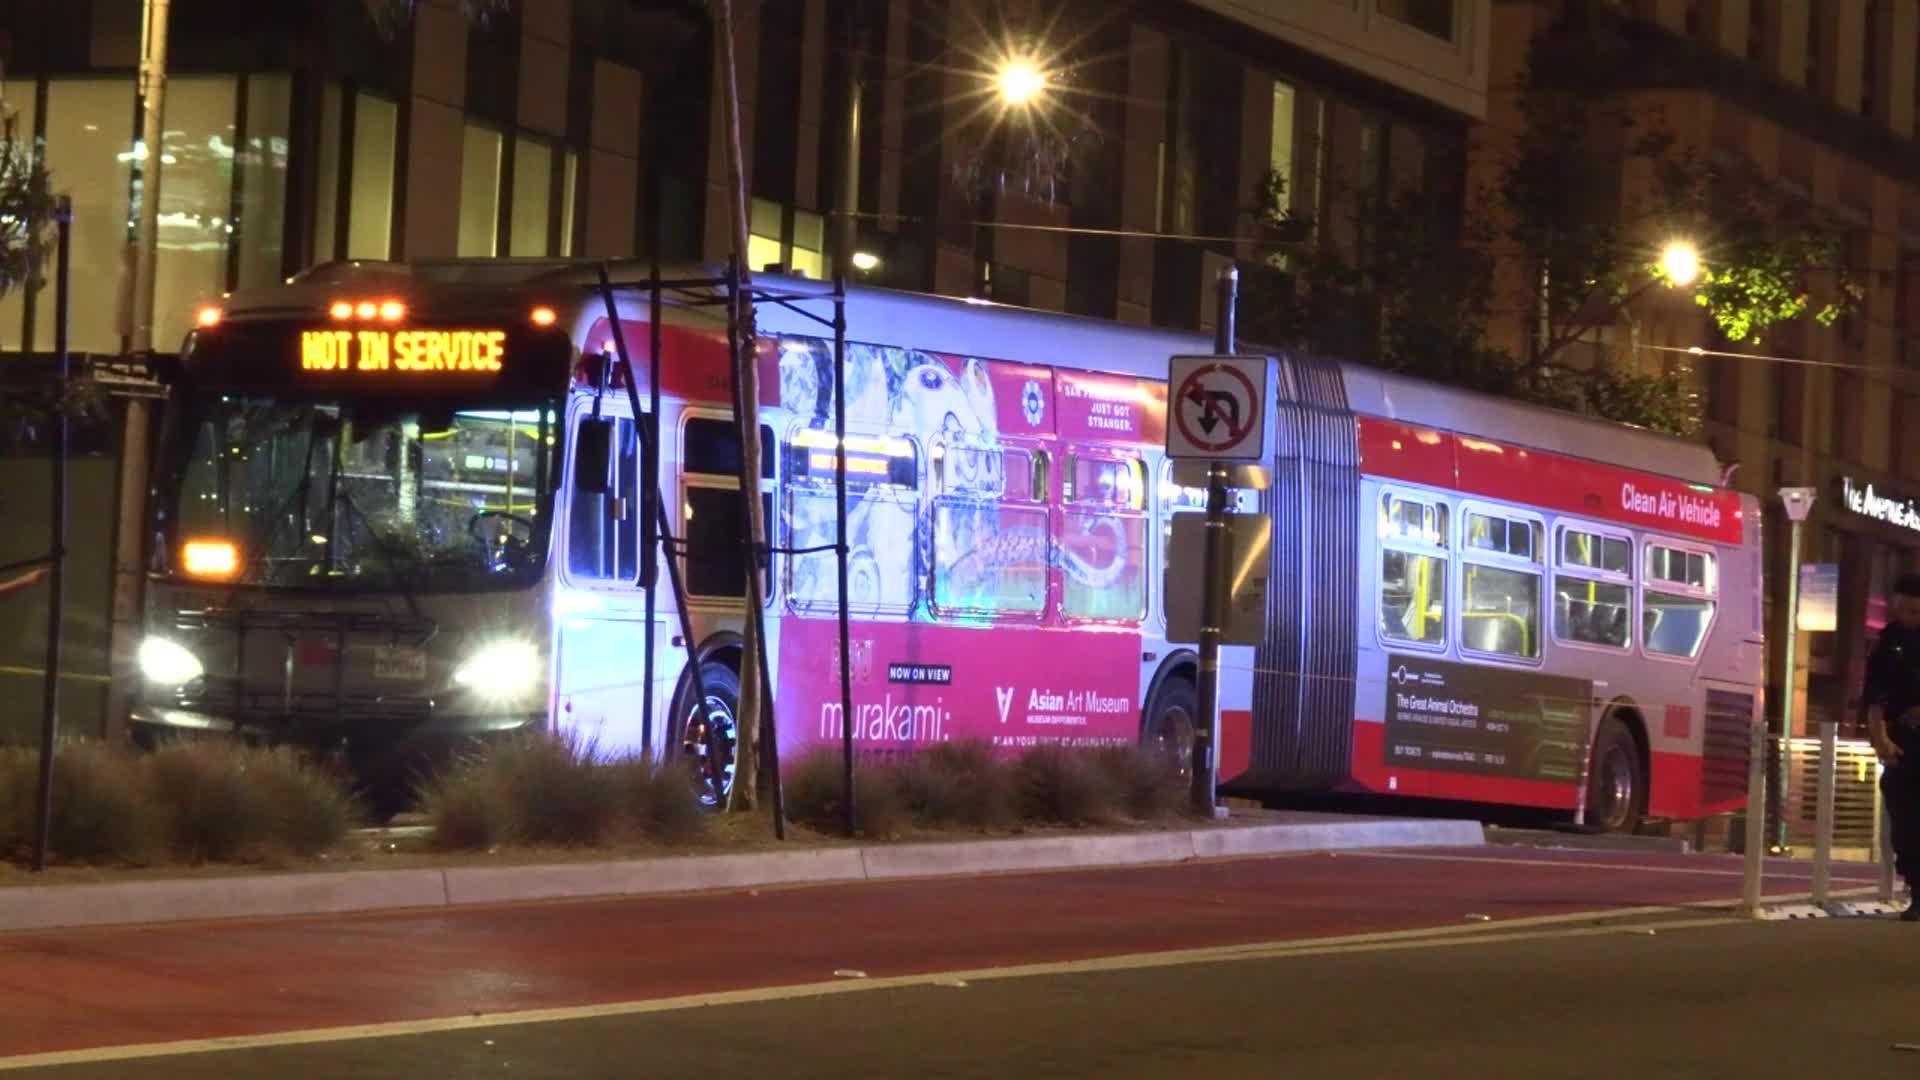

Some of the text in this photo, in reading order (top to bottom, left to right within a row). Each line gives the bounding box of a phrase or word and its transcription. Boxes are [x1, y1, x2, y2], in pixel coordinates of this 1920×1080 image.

[302, 331, 506, 370] NOT IN SERVICE
[1091, 403, 1130, 416] JUST GOT
[1088, 415, 1133, 431] STRANGER.
[1621, 482, 1720, 528] Clean Air Vehicle
[890, 667, 950, 681] NOW ON VIEW
[1028, 688, 1129, 713] Asian Art Museum
[1396, 693, 1409, 709] The
[1409, 695, 1428, 711] Great
[820, 692, 951, 742] murakami:
